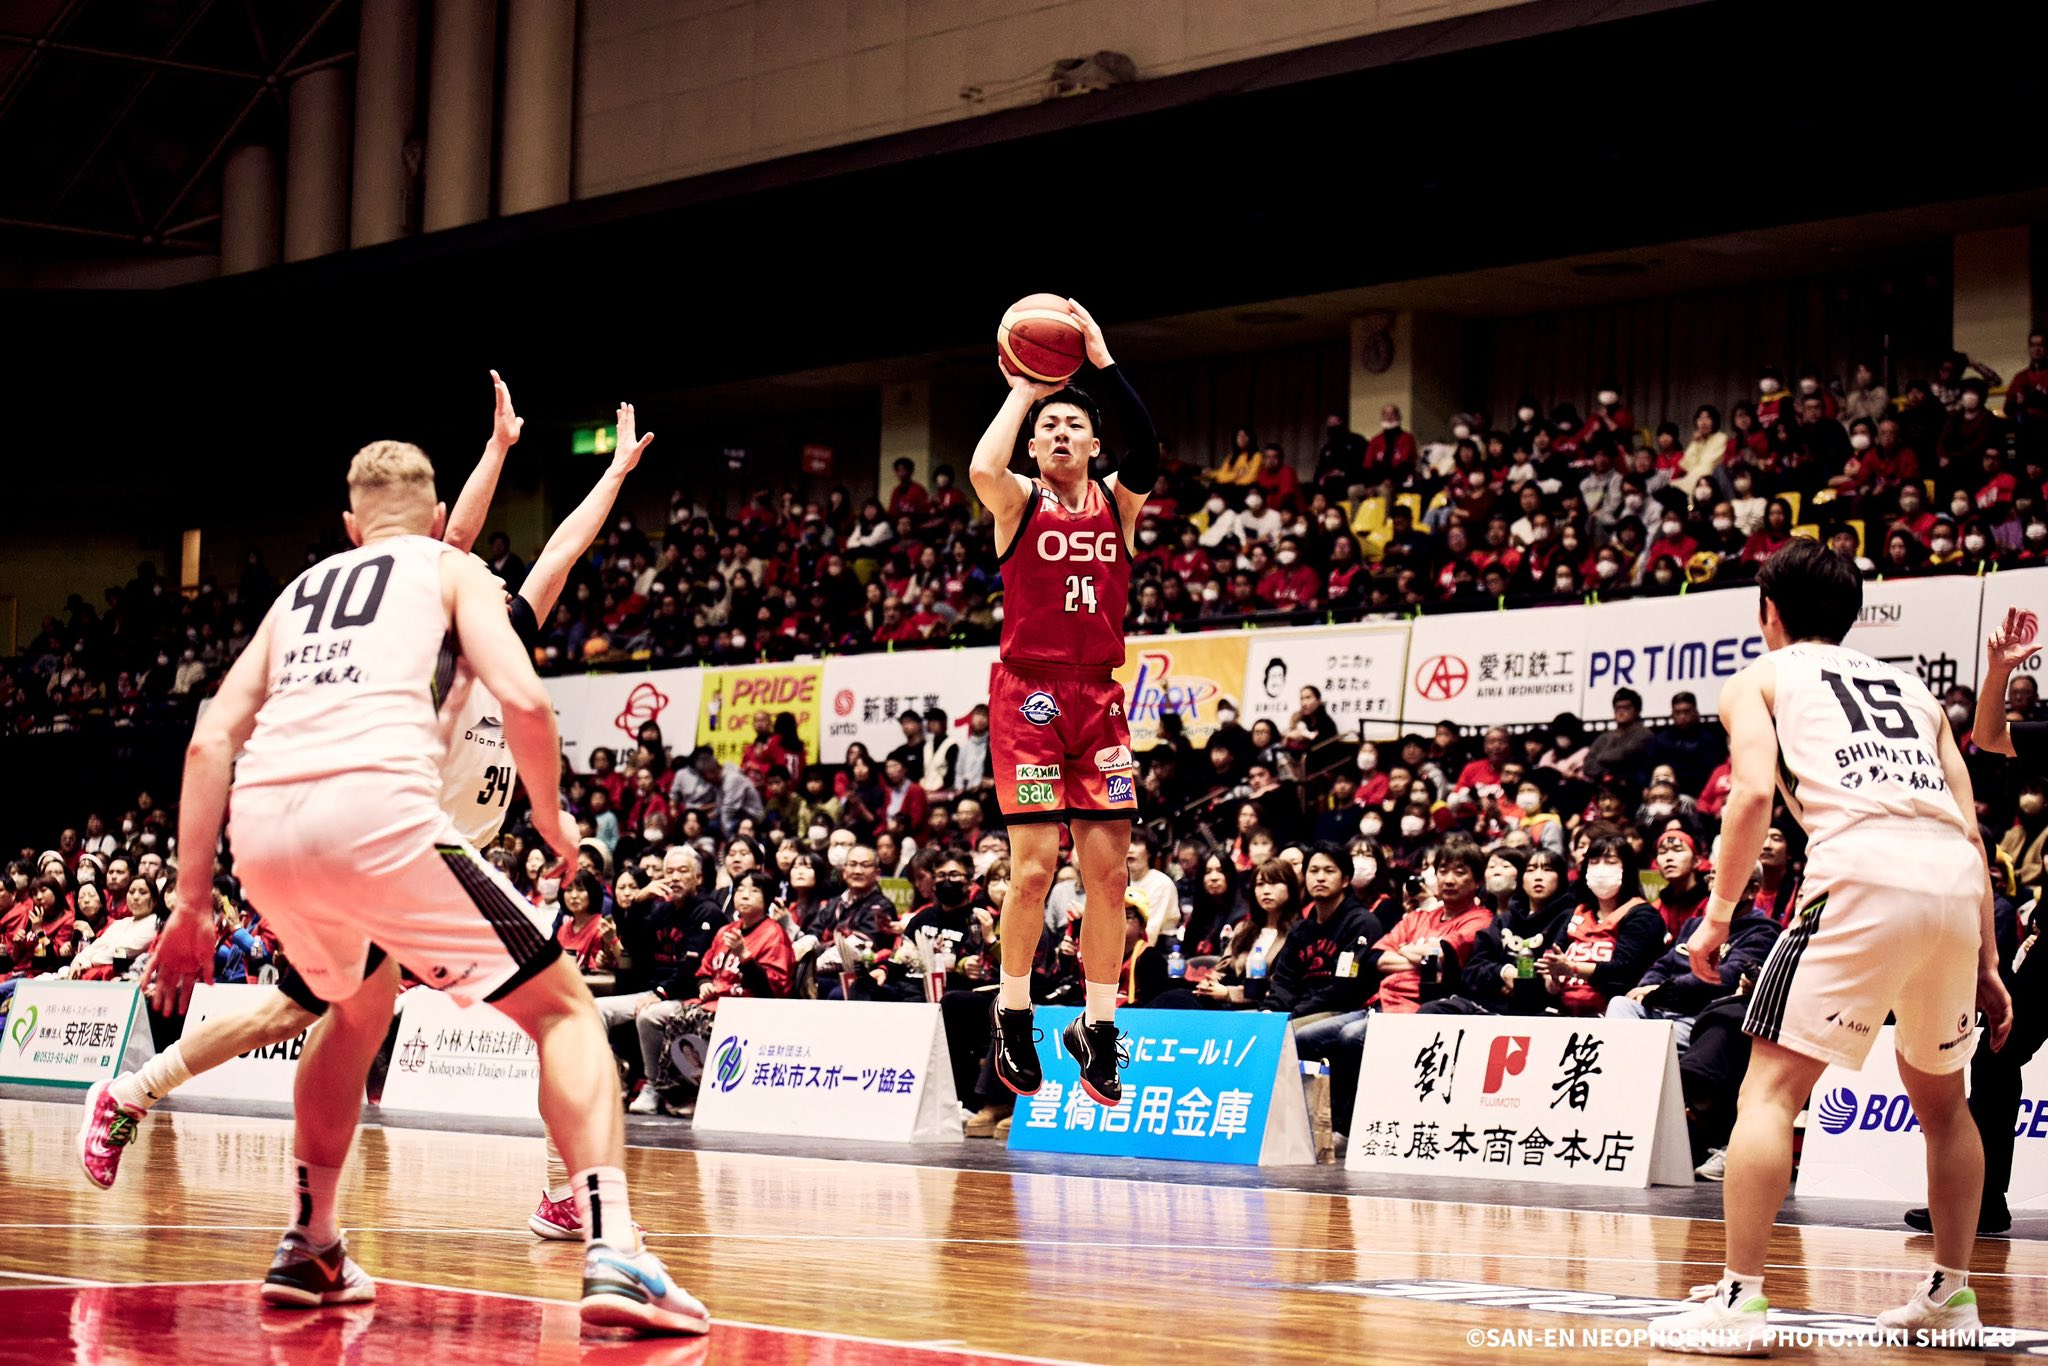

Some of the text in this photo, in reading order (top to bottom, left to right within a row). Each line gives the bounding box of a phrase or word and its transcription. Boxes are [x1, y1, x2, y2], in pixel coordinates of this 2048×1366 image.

[1037, 530, 1117, 563] OSG
[291, 554, 395, 634] 40
[1064, 575, 1097, 613] 24
[284, 639, 352, 667] WELSH
[1479, 650, 1574, 682] 愛和鉄工
[1589, 650, 1636, 688] PR
[1643, 636, 1763, 682] TIMES
[731, 674, 817, 706] PRIDE
[1821, 669, 1920, 739] 15
[477, 765, 511, 808] 34
[63, 1020, 118, 1048] 安形医院
[1846, 1020, 1870, 1034] AGH
[428, 1060, 476, 1078] Kobayashi
[752, 1062, 916, 1095] 浜松市スポーツ協会
[1025, 1078, 1253, 1140] 豊橋信用金庫
[1479, 1096, 1521, 1109] FUJIMOTO
